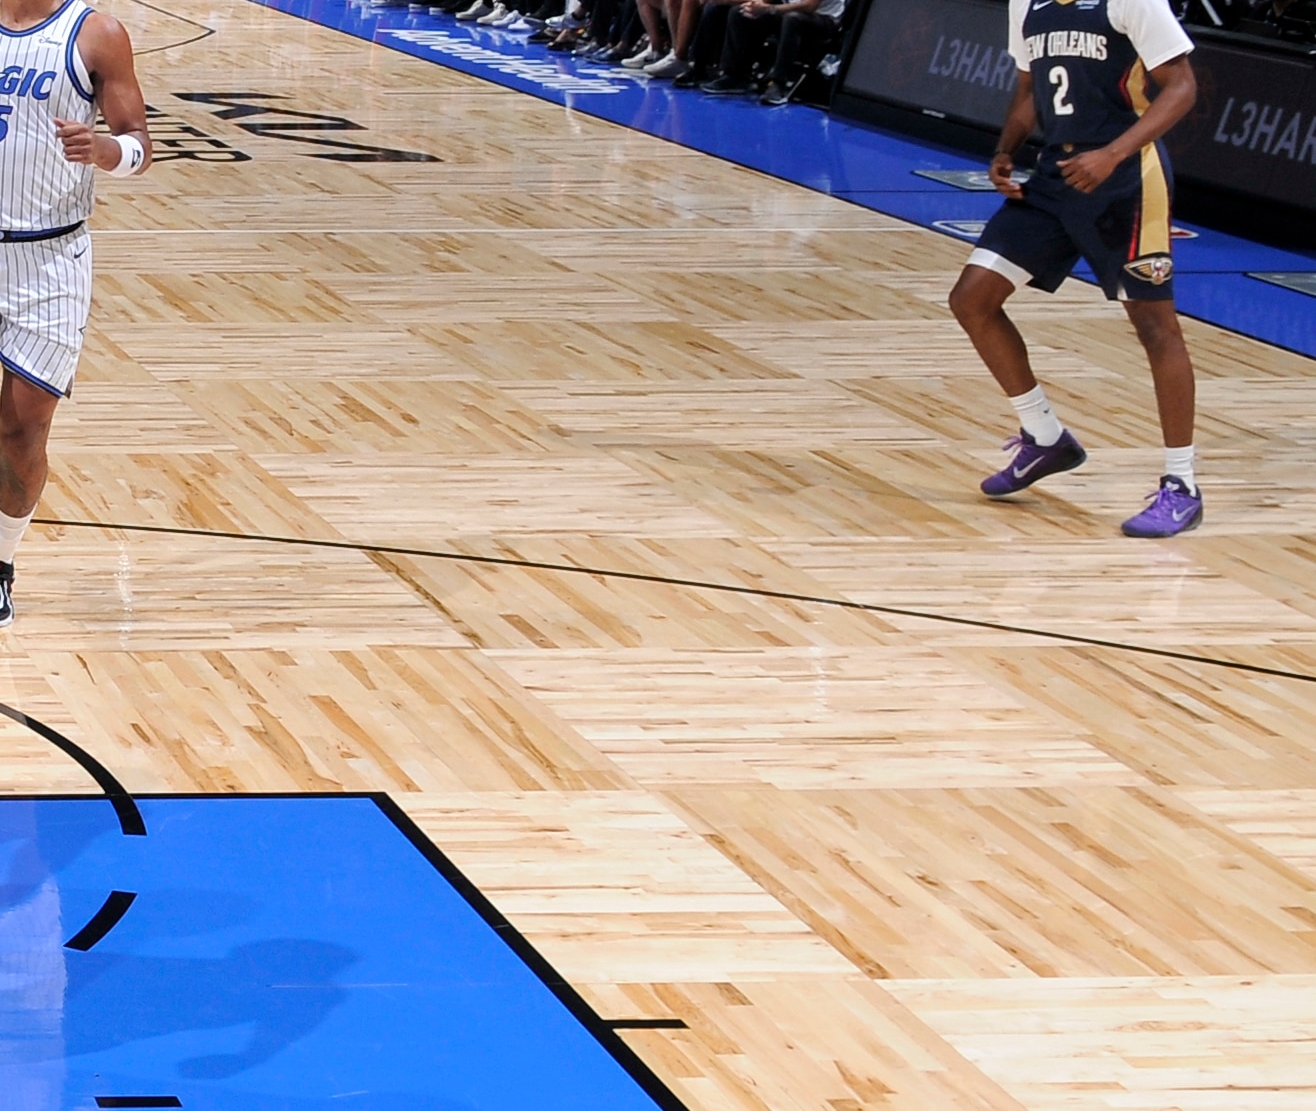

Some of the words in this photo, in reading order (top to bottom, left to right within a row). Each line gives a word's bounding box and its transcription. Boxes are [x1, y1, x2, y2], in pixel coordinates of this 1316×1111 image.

[928, 36, 1017, 91] L3HAR
[1025, 33, 1047, 62] EW
[1048, 30, 1108, 61] ORLEANS
[1049, 65, 1074, 115] 2
